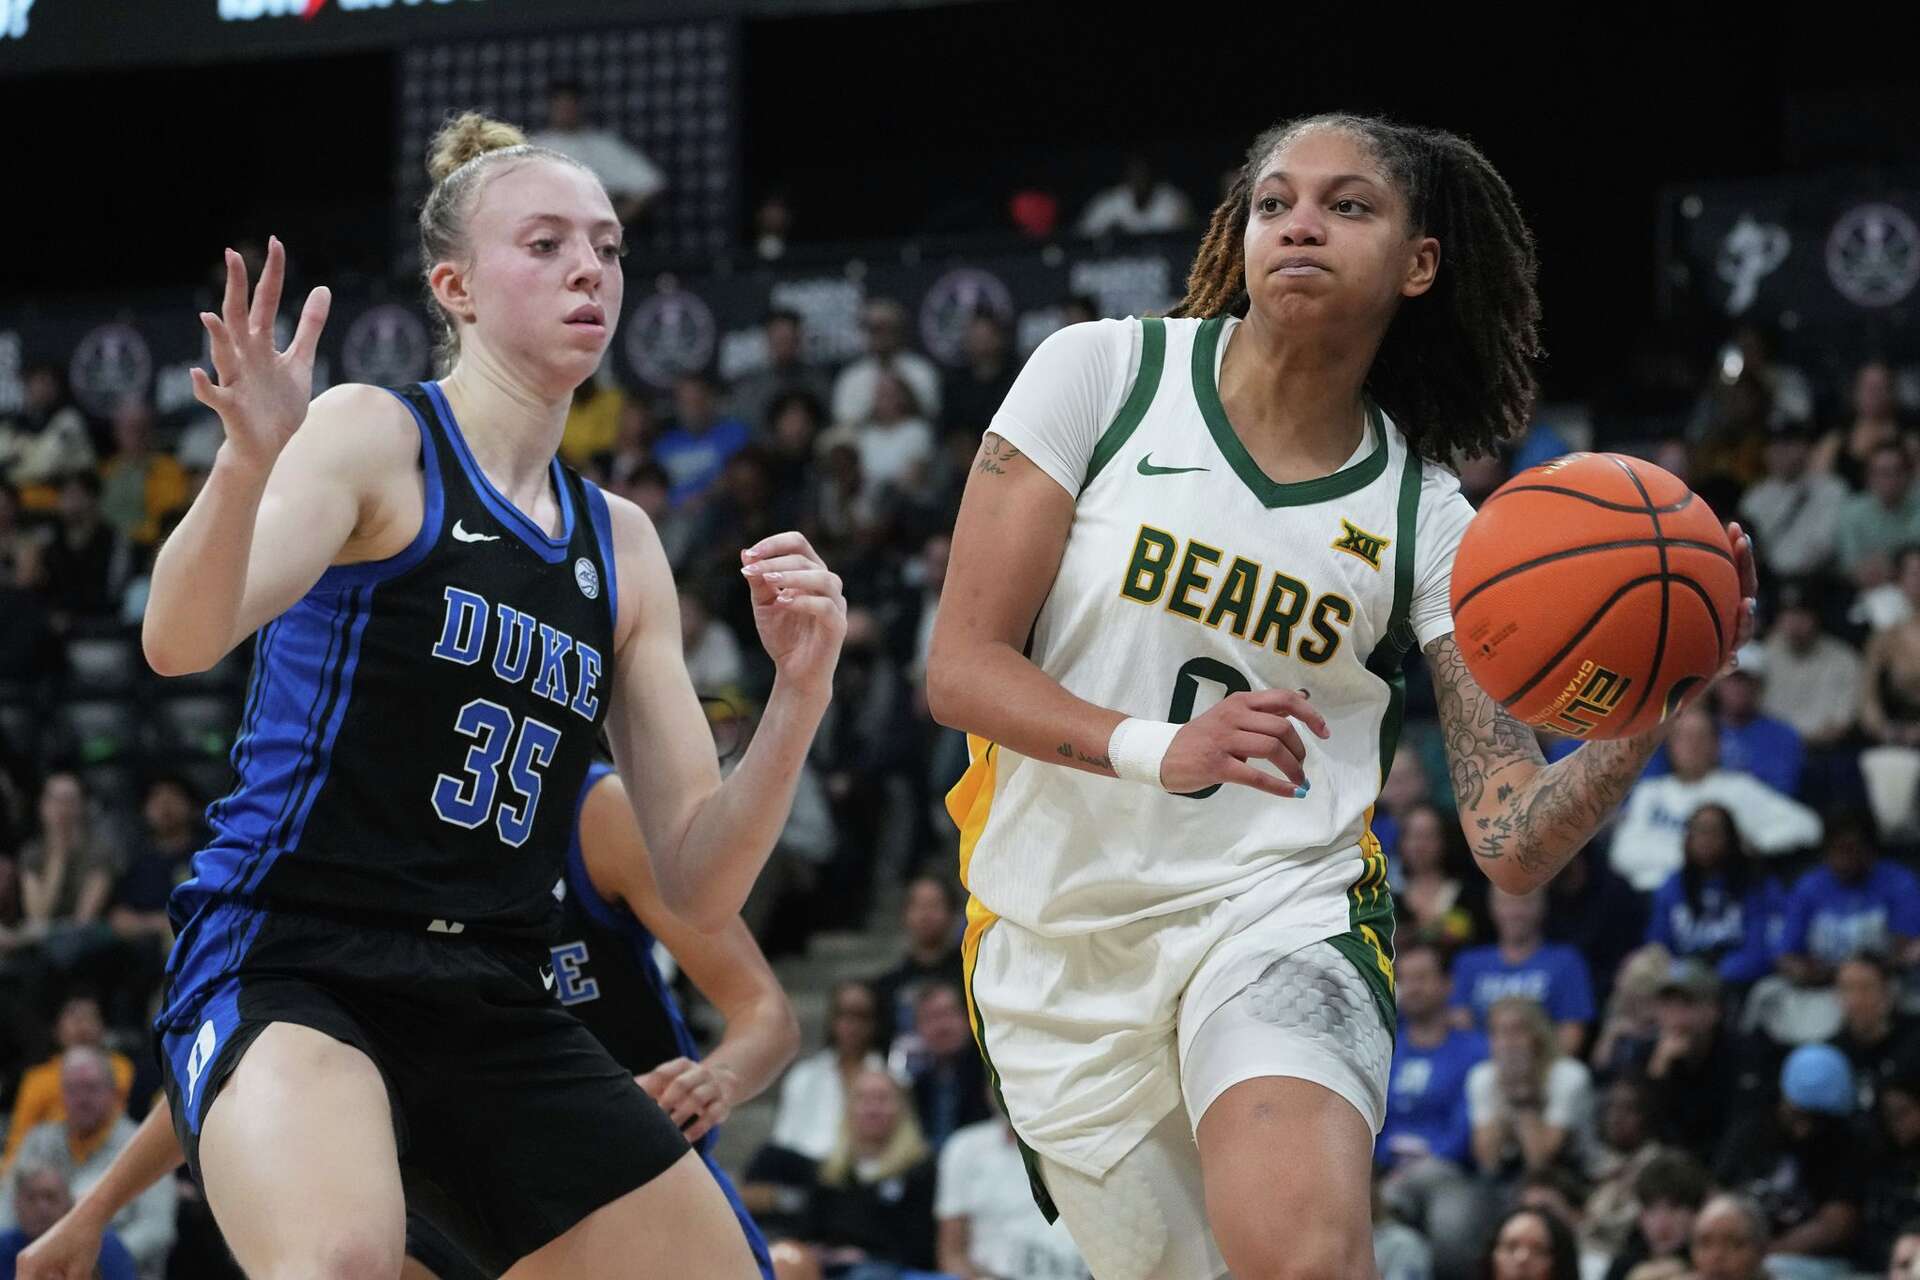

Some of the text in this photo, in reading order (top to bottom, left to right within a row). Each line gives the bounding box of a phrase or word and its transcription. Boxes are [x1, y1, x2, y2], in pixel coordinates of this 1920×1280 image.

[432, 586, 602, 722] DUKE
[1119, 523, 1354, 667] BEARS
[1527, 660, 1595, 723] CHAMPION
[431, 698, 562, 848] 35
[550, 940, 601, 1006] E
